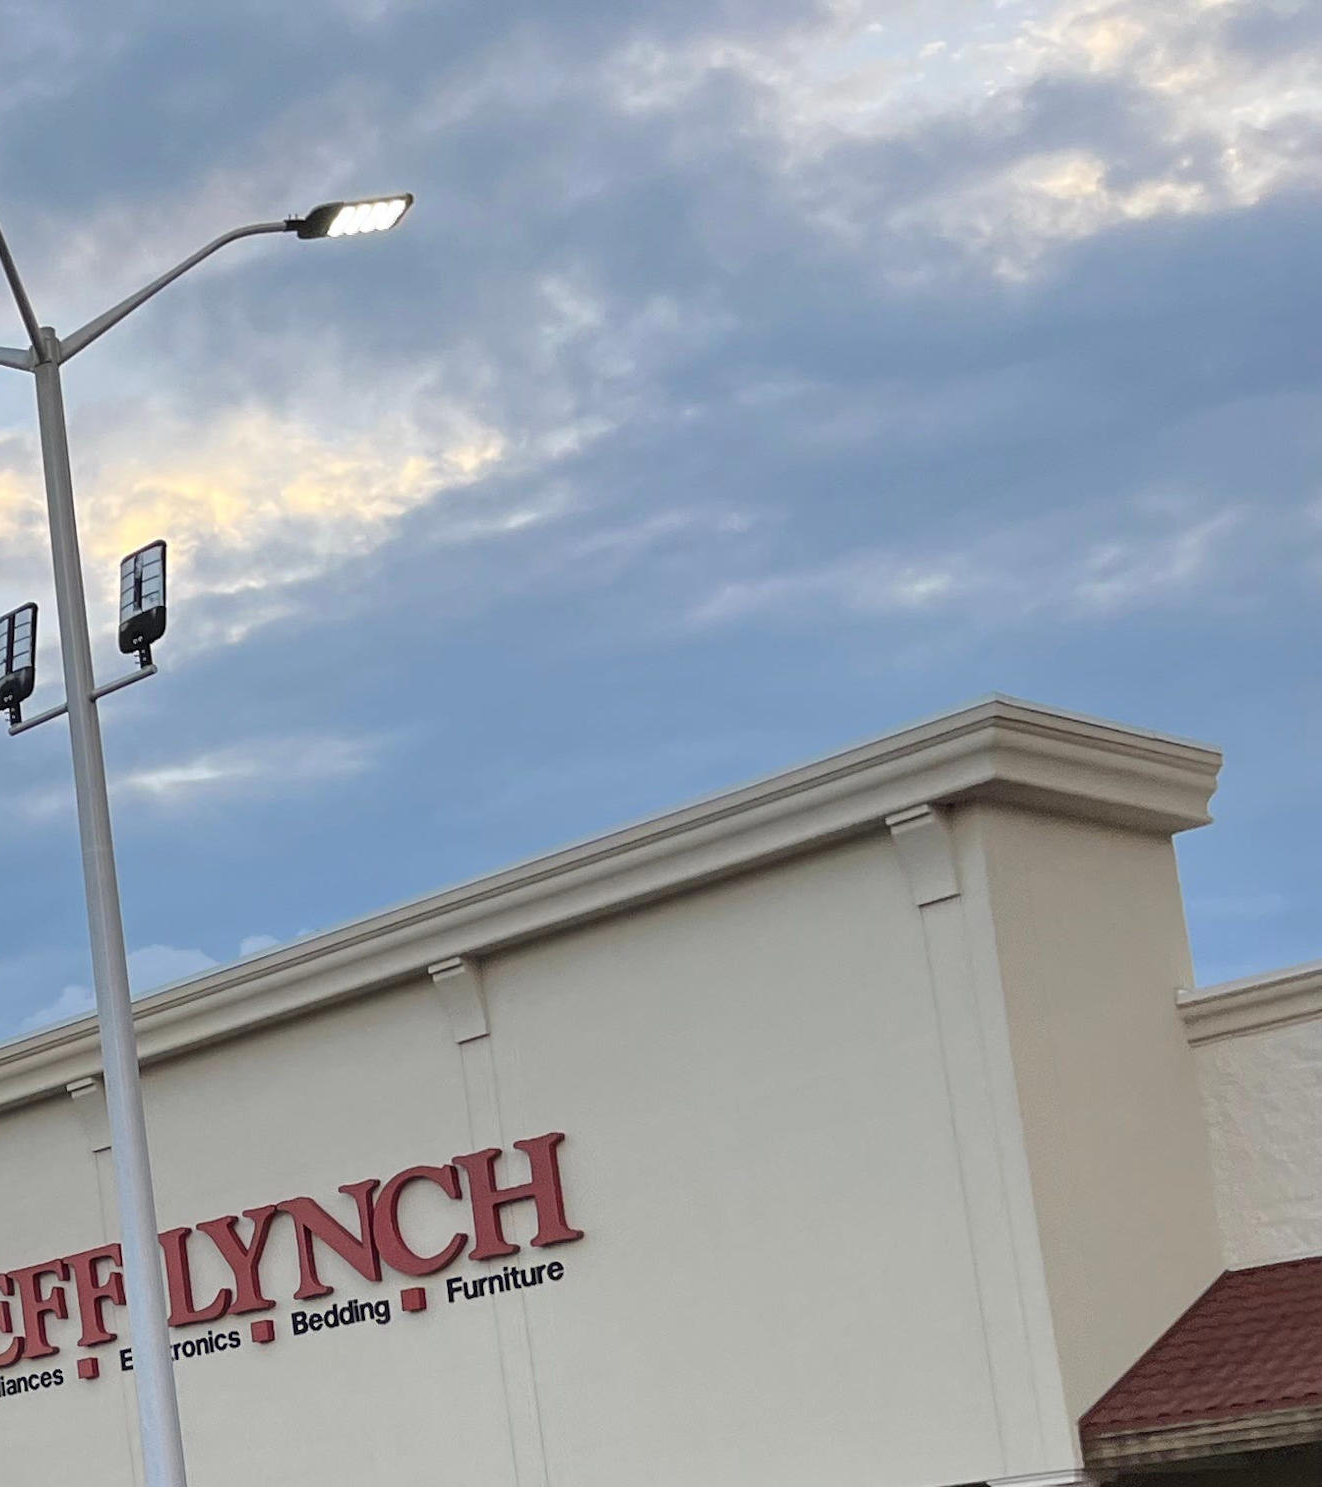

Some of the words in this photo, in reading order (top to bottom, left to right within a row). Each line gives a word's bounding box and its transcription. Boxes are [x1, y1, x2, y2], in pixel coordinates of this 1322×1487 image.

[157, 1132, 584, 1326] LYNCH
[120, 1329, 242, 1371] Eronics
[291, 1297, 391, 1336] Bedding
[446, 1260, 565, 1303] Furniture
